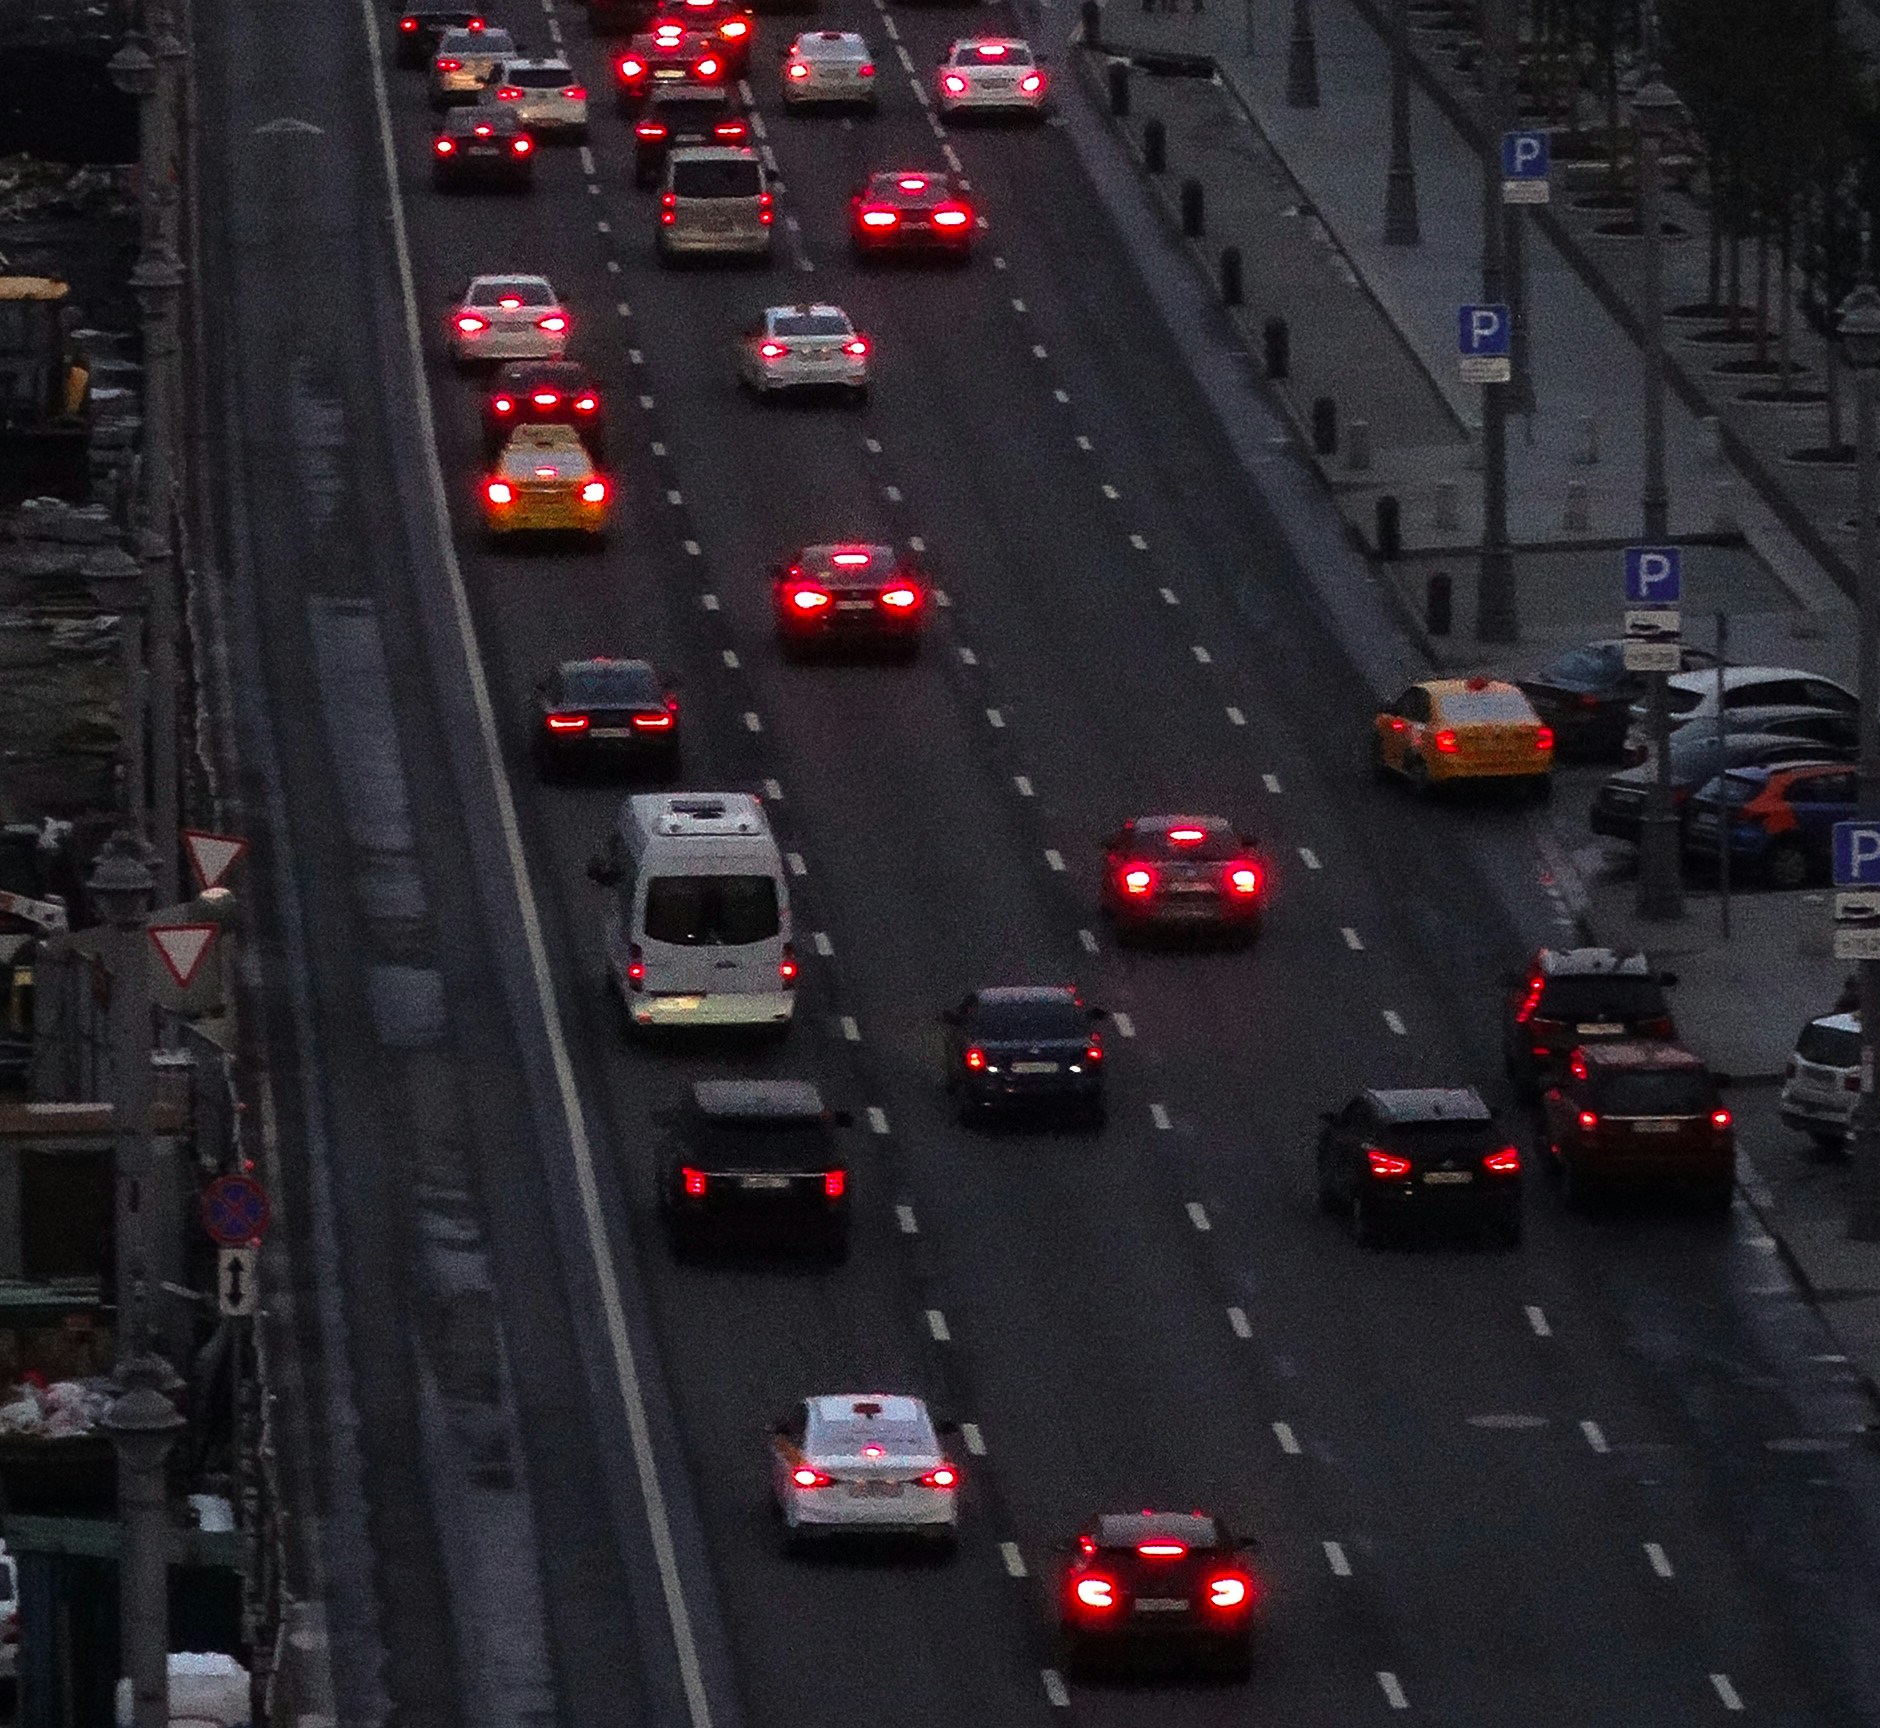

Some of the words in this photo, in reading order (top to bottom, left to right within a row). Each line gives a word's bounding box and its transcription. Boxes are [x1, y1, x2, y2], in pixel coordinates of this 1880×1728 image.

[1515, 137, 1540, 172] P
[1473, 310, 1499, 348] P
[1639, 553, 1671, 597] P
